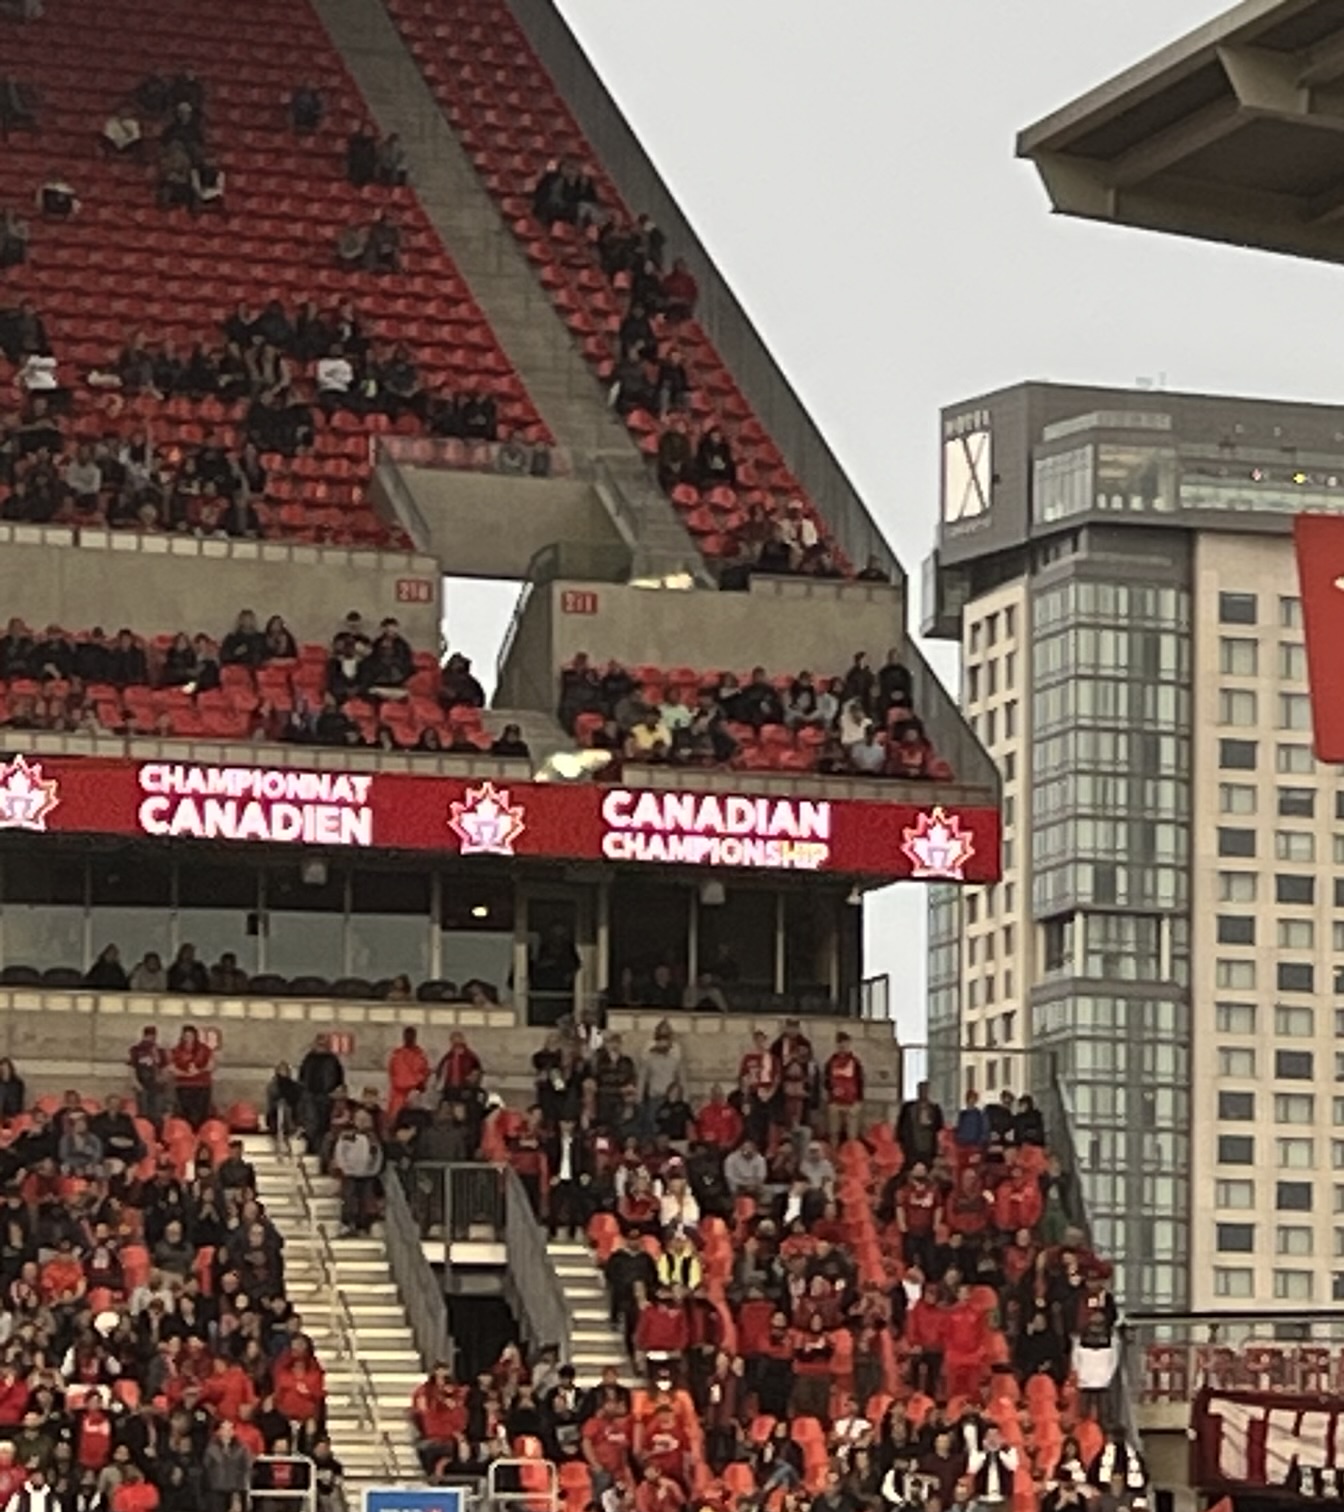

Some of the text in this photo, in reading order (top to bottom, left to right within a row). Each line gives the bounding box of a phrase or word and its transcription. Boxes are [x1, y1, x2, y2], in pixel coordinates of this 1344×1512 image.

[139, 764, 373, 804] CHAMPIONNAT
[138, 795, 373, 846] CANADIEN
[602, 790, 831, 839] CANADIAN
[602, 832, 830, 871] CHAMPIONSHIP
